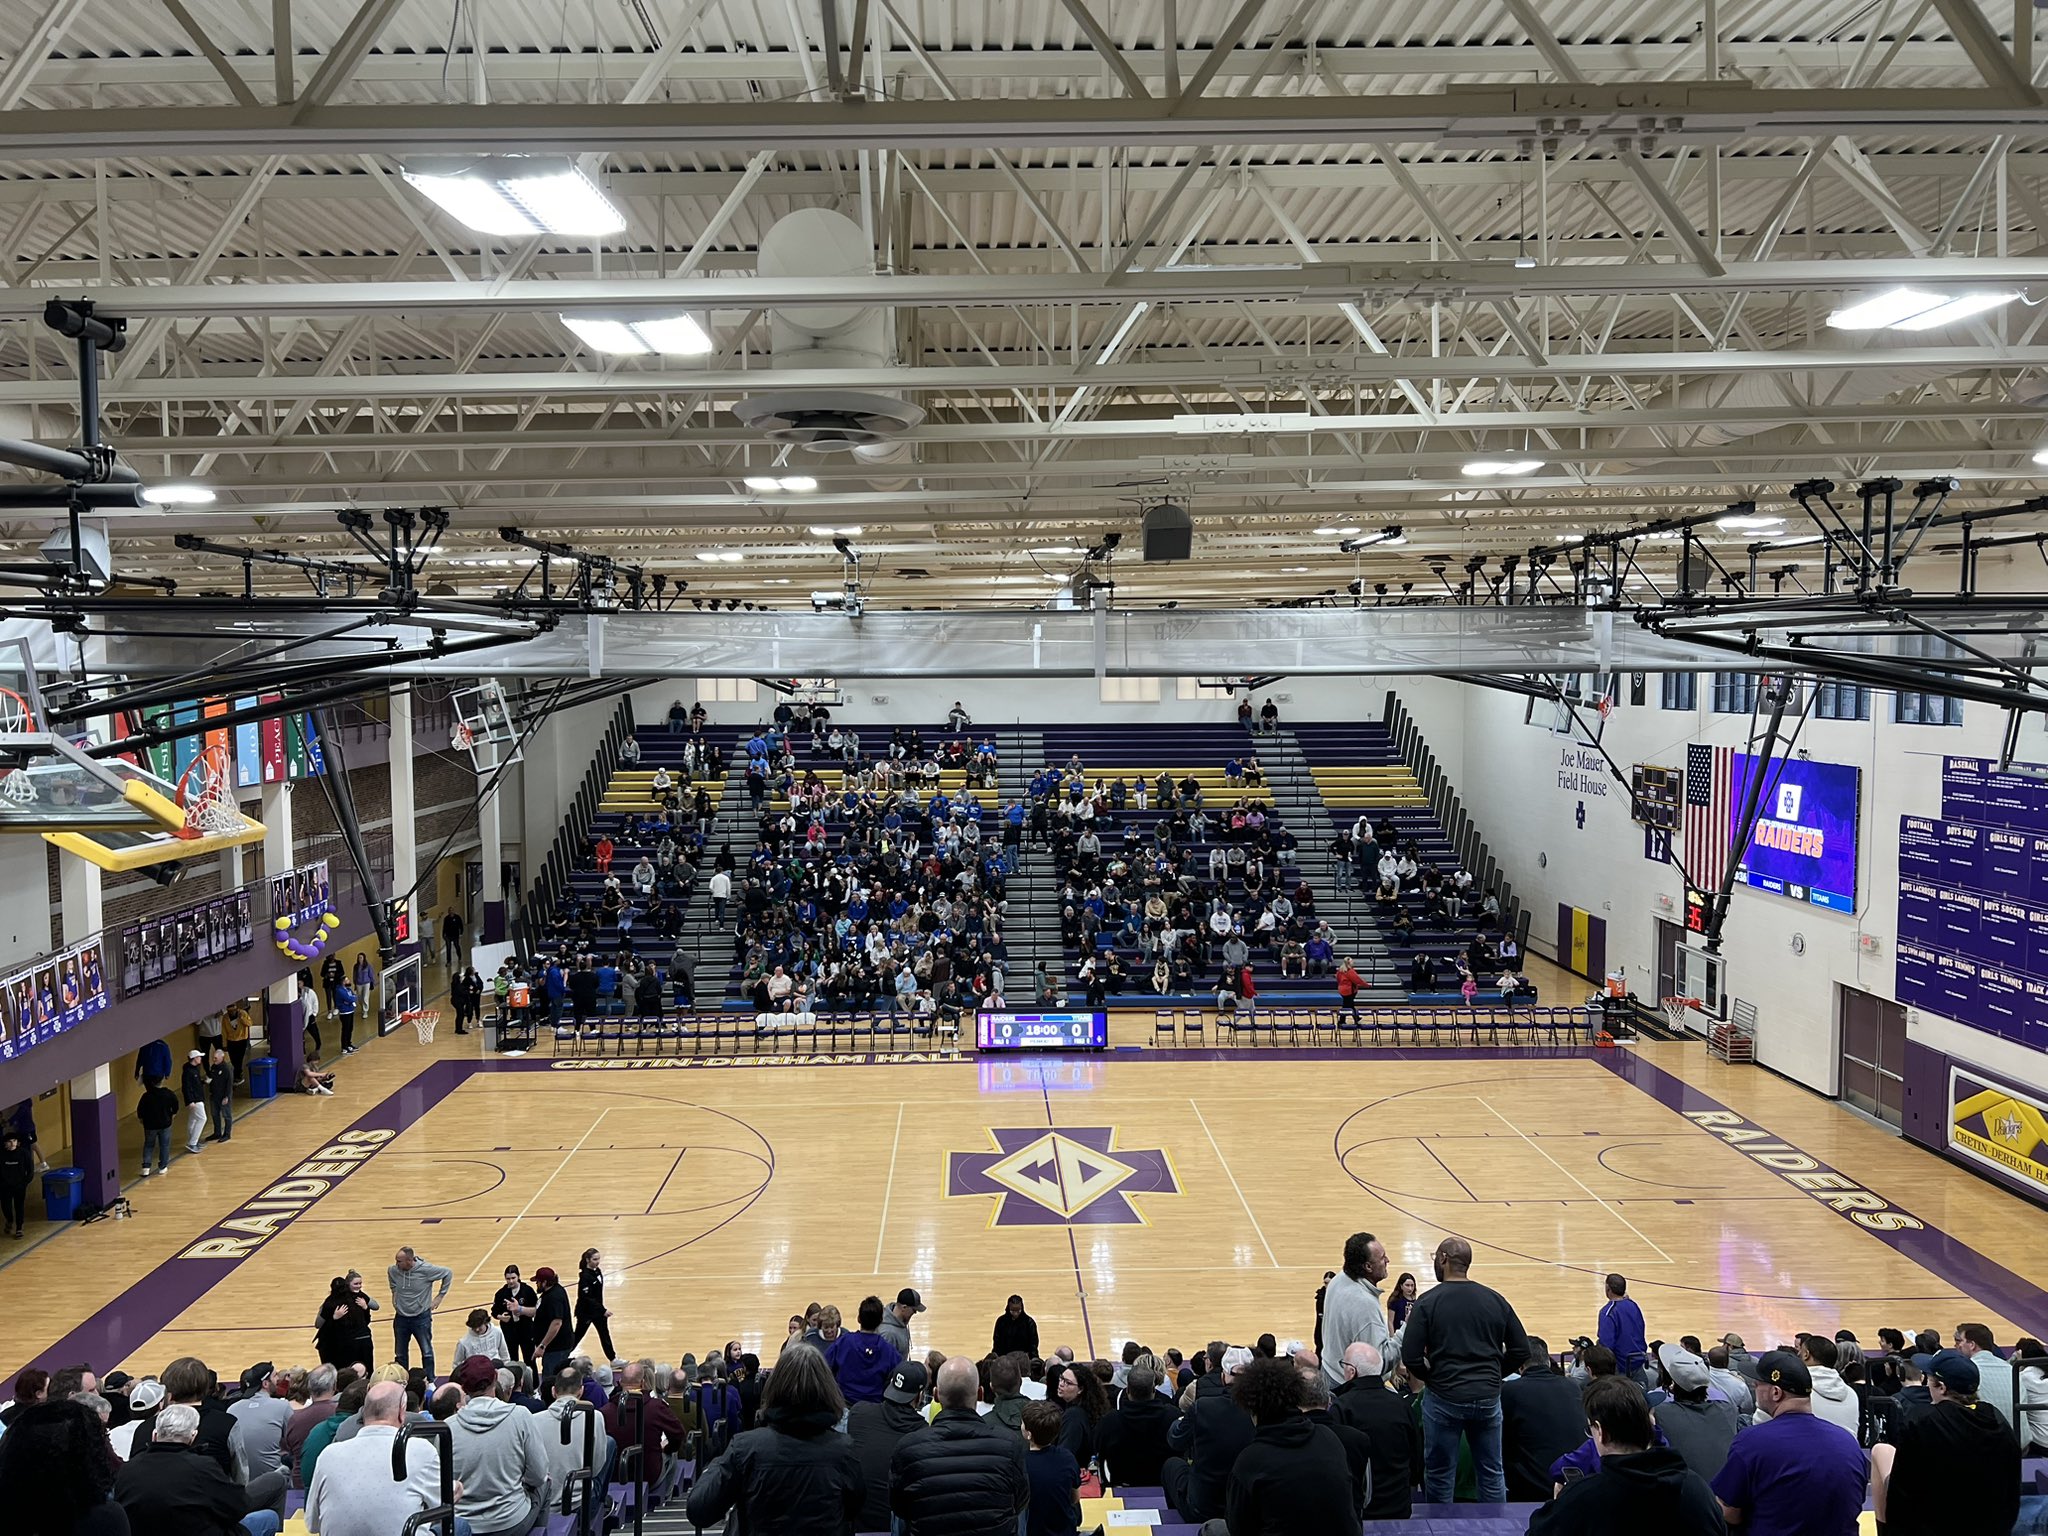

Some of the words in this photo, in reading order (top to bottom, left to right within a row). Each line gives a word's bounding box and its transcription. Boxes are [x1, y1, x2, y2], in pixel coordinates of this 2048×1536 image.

[1560, 749, 1575, 767] Joe
[1577, 751, 1605, 772] Mauer
[1949, 760, 1979, 772] BASEBALL
[1558, 771, 1579, 791] Field
[1580, 774, 1607, 796] House
[1907, 819, 1933, 833] FOOTBALL
[1946, 826, 1962, 836] BOYS
[1962, 828, 1978, 839] GOLF
[1754, 823, 1825, 859] RAIDERS
[1989, 832, 2008, 844] GIRLS
[2009, 835, 2025, 847] GOLF
[1762, 879, 1782, 891] RAIDERS
[1790, 884, 1804, 899] VS
[1812, 892, 1830, 904] TITANS
[1900, 882, 1912, 892] BOYS
[1913, 884, 1937, 899] LACROSSE
[1939, 890, 1954, 901] GIRLS
[1954, 894, 1980, 909] LACROSSE
[1688, 905, 1702, 931] 35
[1984, 900, 2000, 911] BOYS
[2000, 904, 2026, 920] SOCCER
[1938, 956, 1953, 967] BOYS
[1954, 960, 1976, 976] TENNIS
[1981, 968, 1999, 980] GIRLS
[2000, 974, 2023, 990] TENNIS
[2026, 982, 2044, 995] TRACK
[1001, 1024, 1012, 1037] 0
[1025, 1024, 1058, 1036] 18:00
[1071, 1023, 1082, 1037] 0
[551, 1053, 866, 1069] CRETIN-DERHAM
[874, 1053, 974, 1064] HALL
[1681, 1110, 1925, 1231] RAIDERS
[177, 1128, 397, 1260] RAIDERS
[894, 1372, 905, 1389] S
